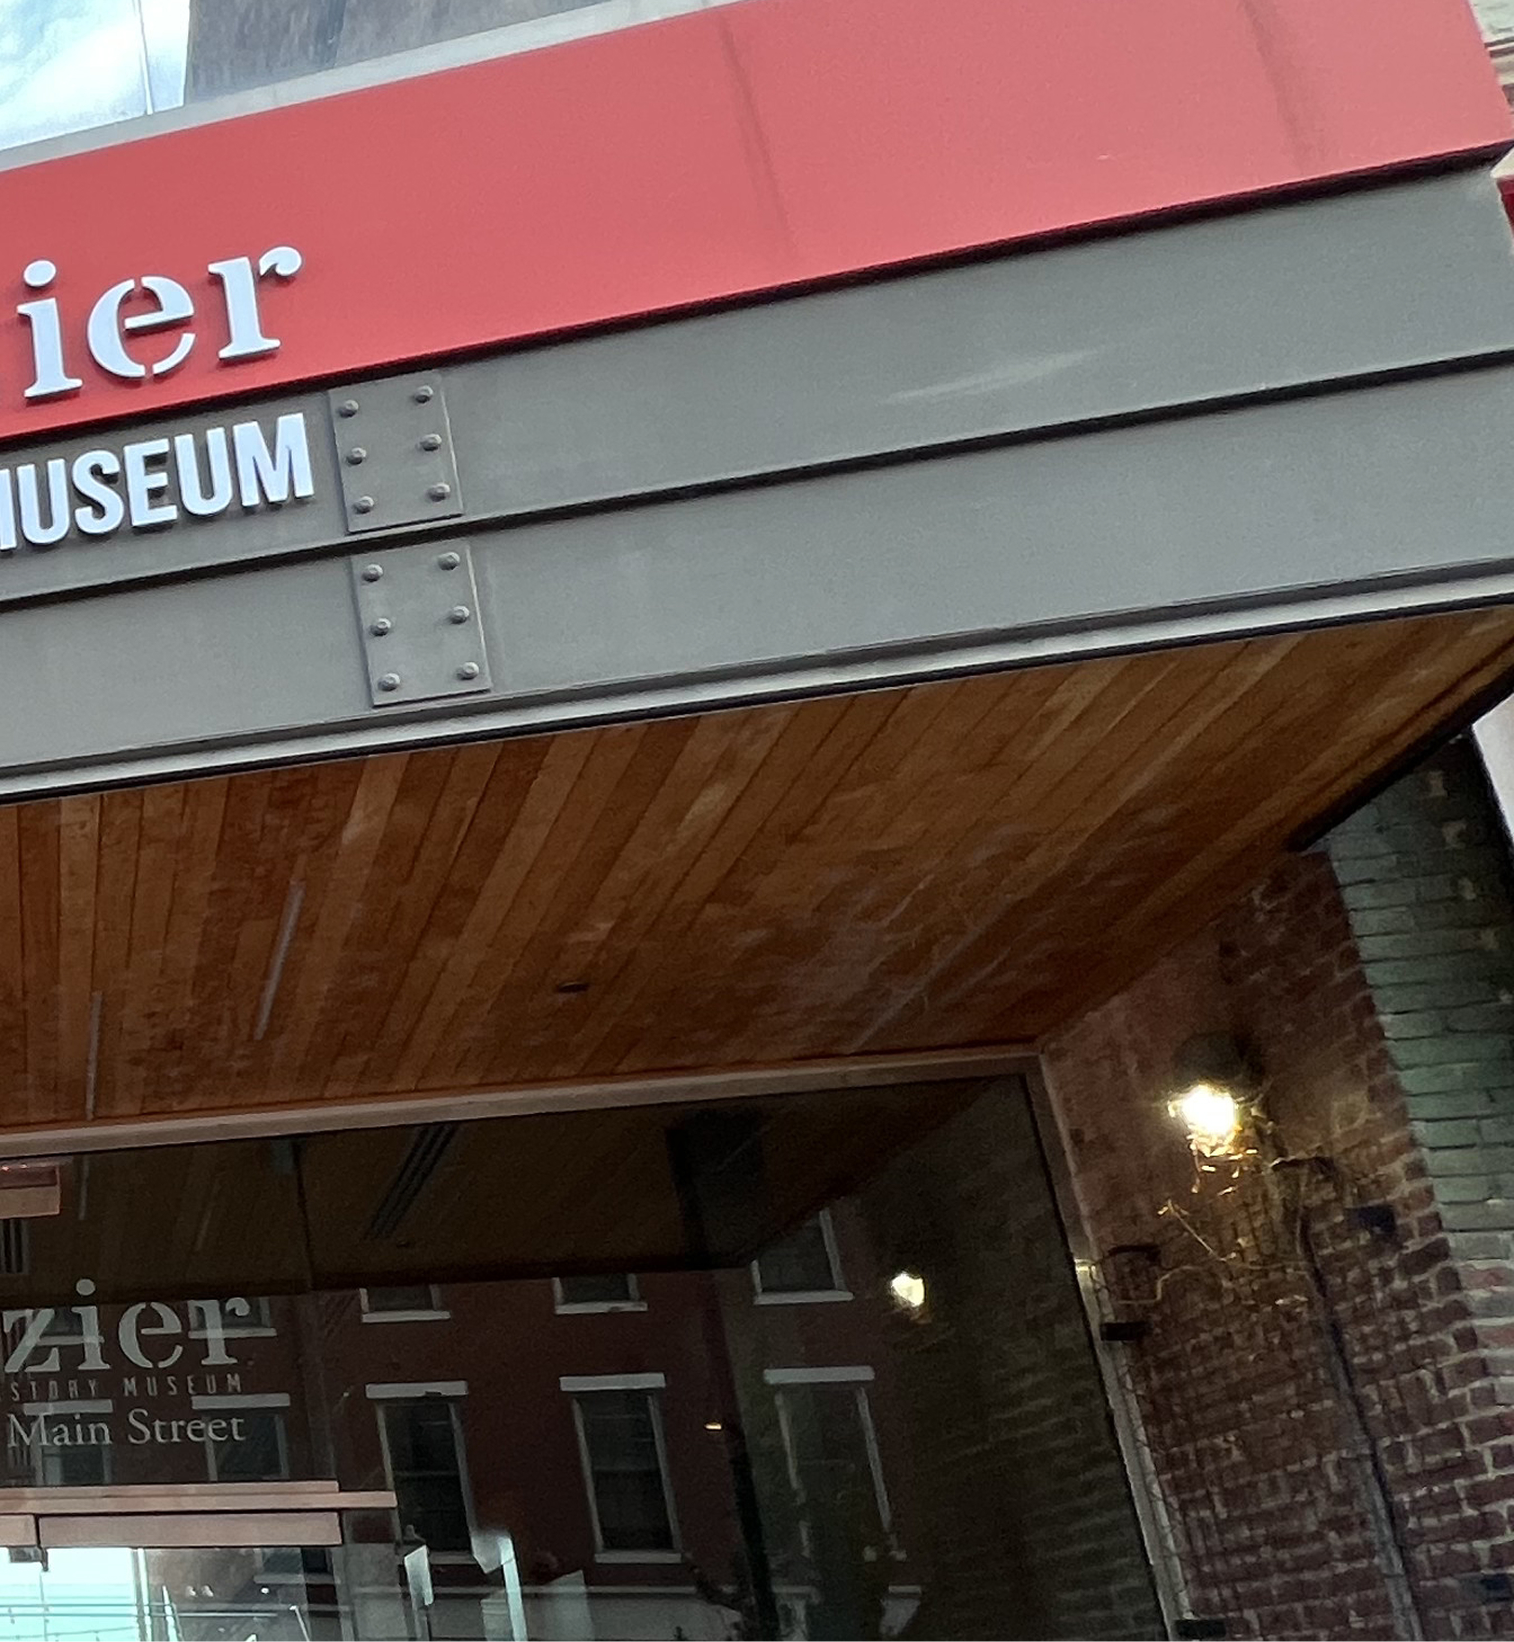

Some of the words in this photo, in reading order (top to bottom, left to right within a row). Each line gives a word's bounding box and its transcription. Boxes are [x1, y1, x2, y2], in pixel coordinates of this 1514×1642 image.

[123, 1373, 243, 1398] MUSEUM
[6, 1412, 113, 1447] Main
[127, 1408, 247, 1445] Street
